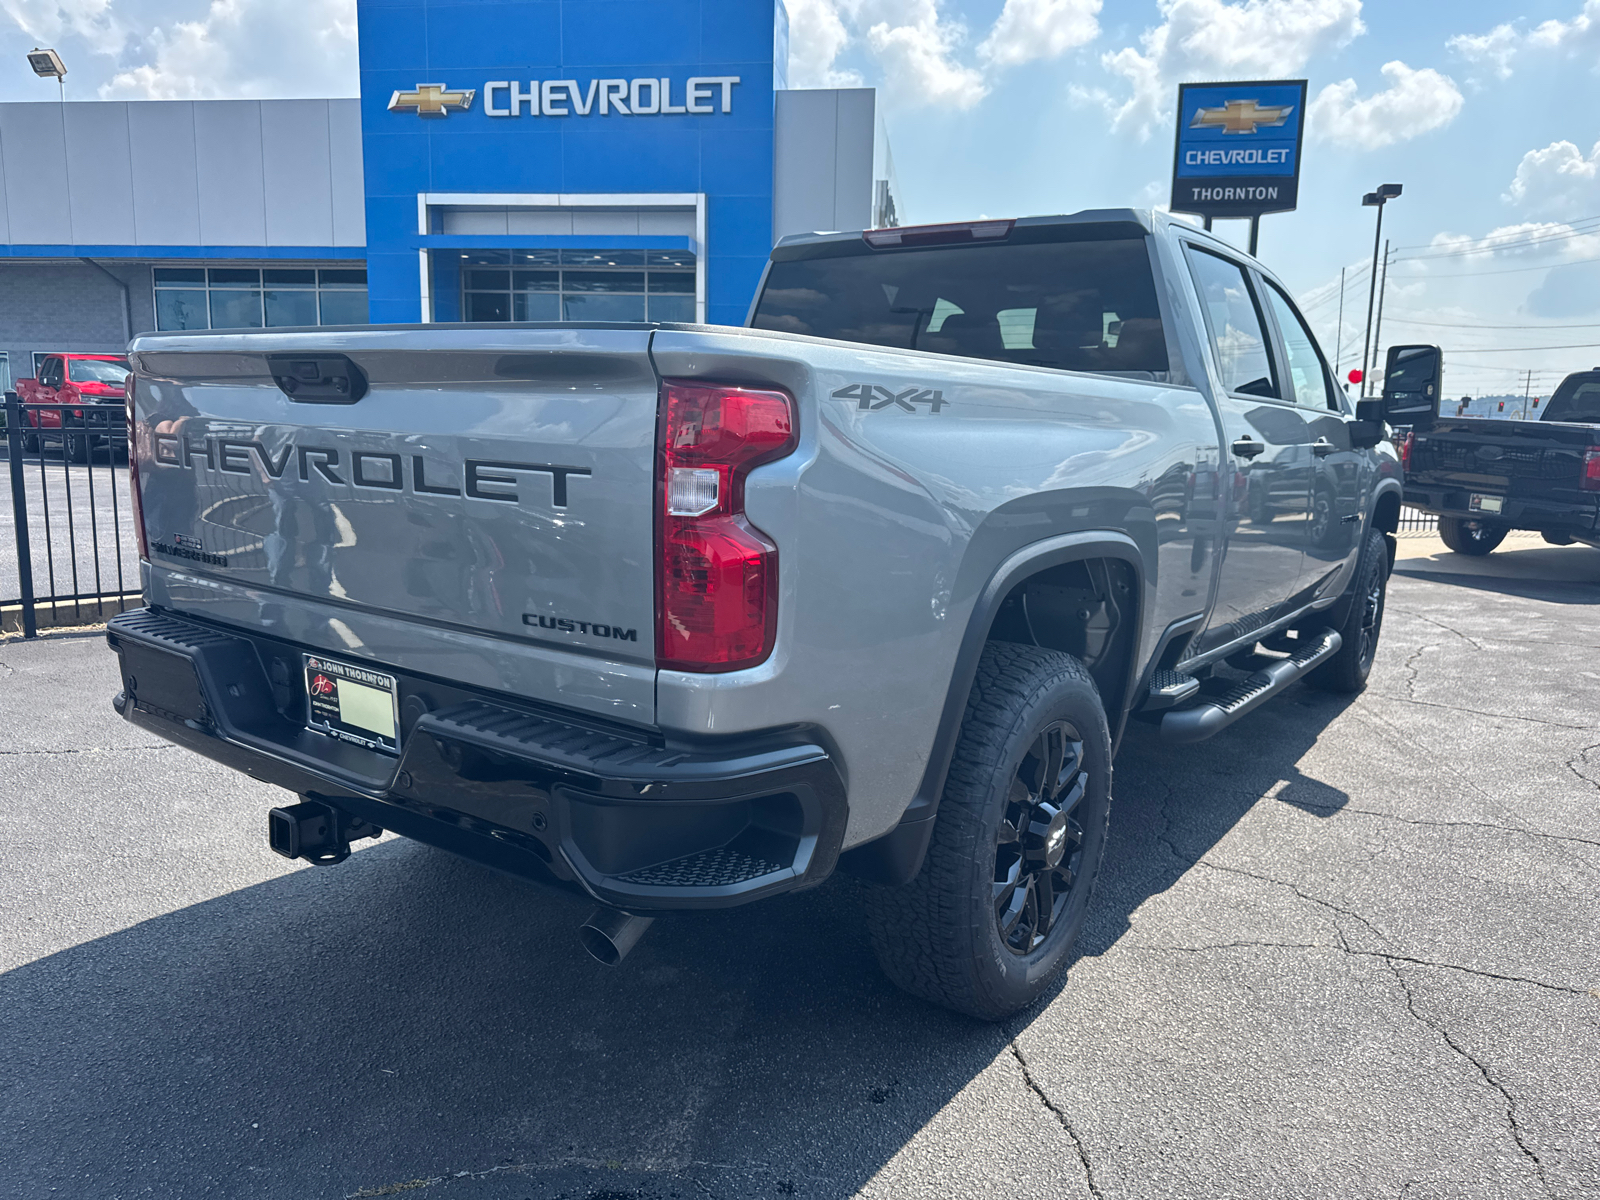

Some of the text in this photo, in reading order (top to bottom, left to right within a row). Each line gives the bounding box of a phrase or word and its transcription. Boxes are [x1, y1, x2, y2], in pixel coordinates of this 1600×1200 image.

[484, 76, 741, 116] CHEVROLET
[1185, 149, 1290, 165] CHEVROLET
[1191, 186, 1279, 201] THORNTON
[153, 431, 592, 508] CHEVROLET
[521, 613, 638, 642] CUSTOM
[322, 661, 344, 675] JOHN
[344, 667, 391, 688] THORNTON
[339, 732, 367, 746] CHEVROLET
